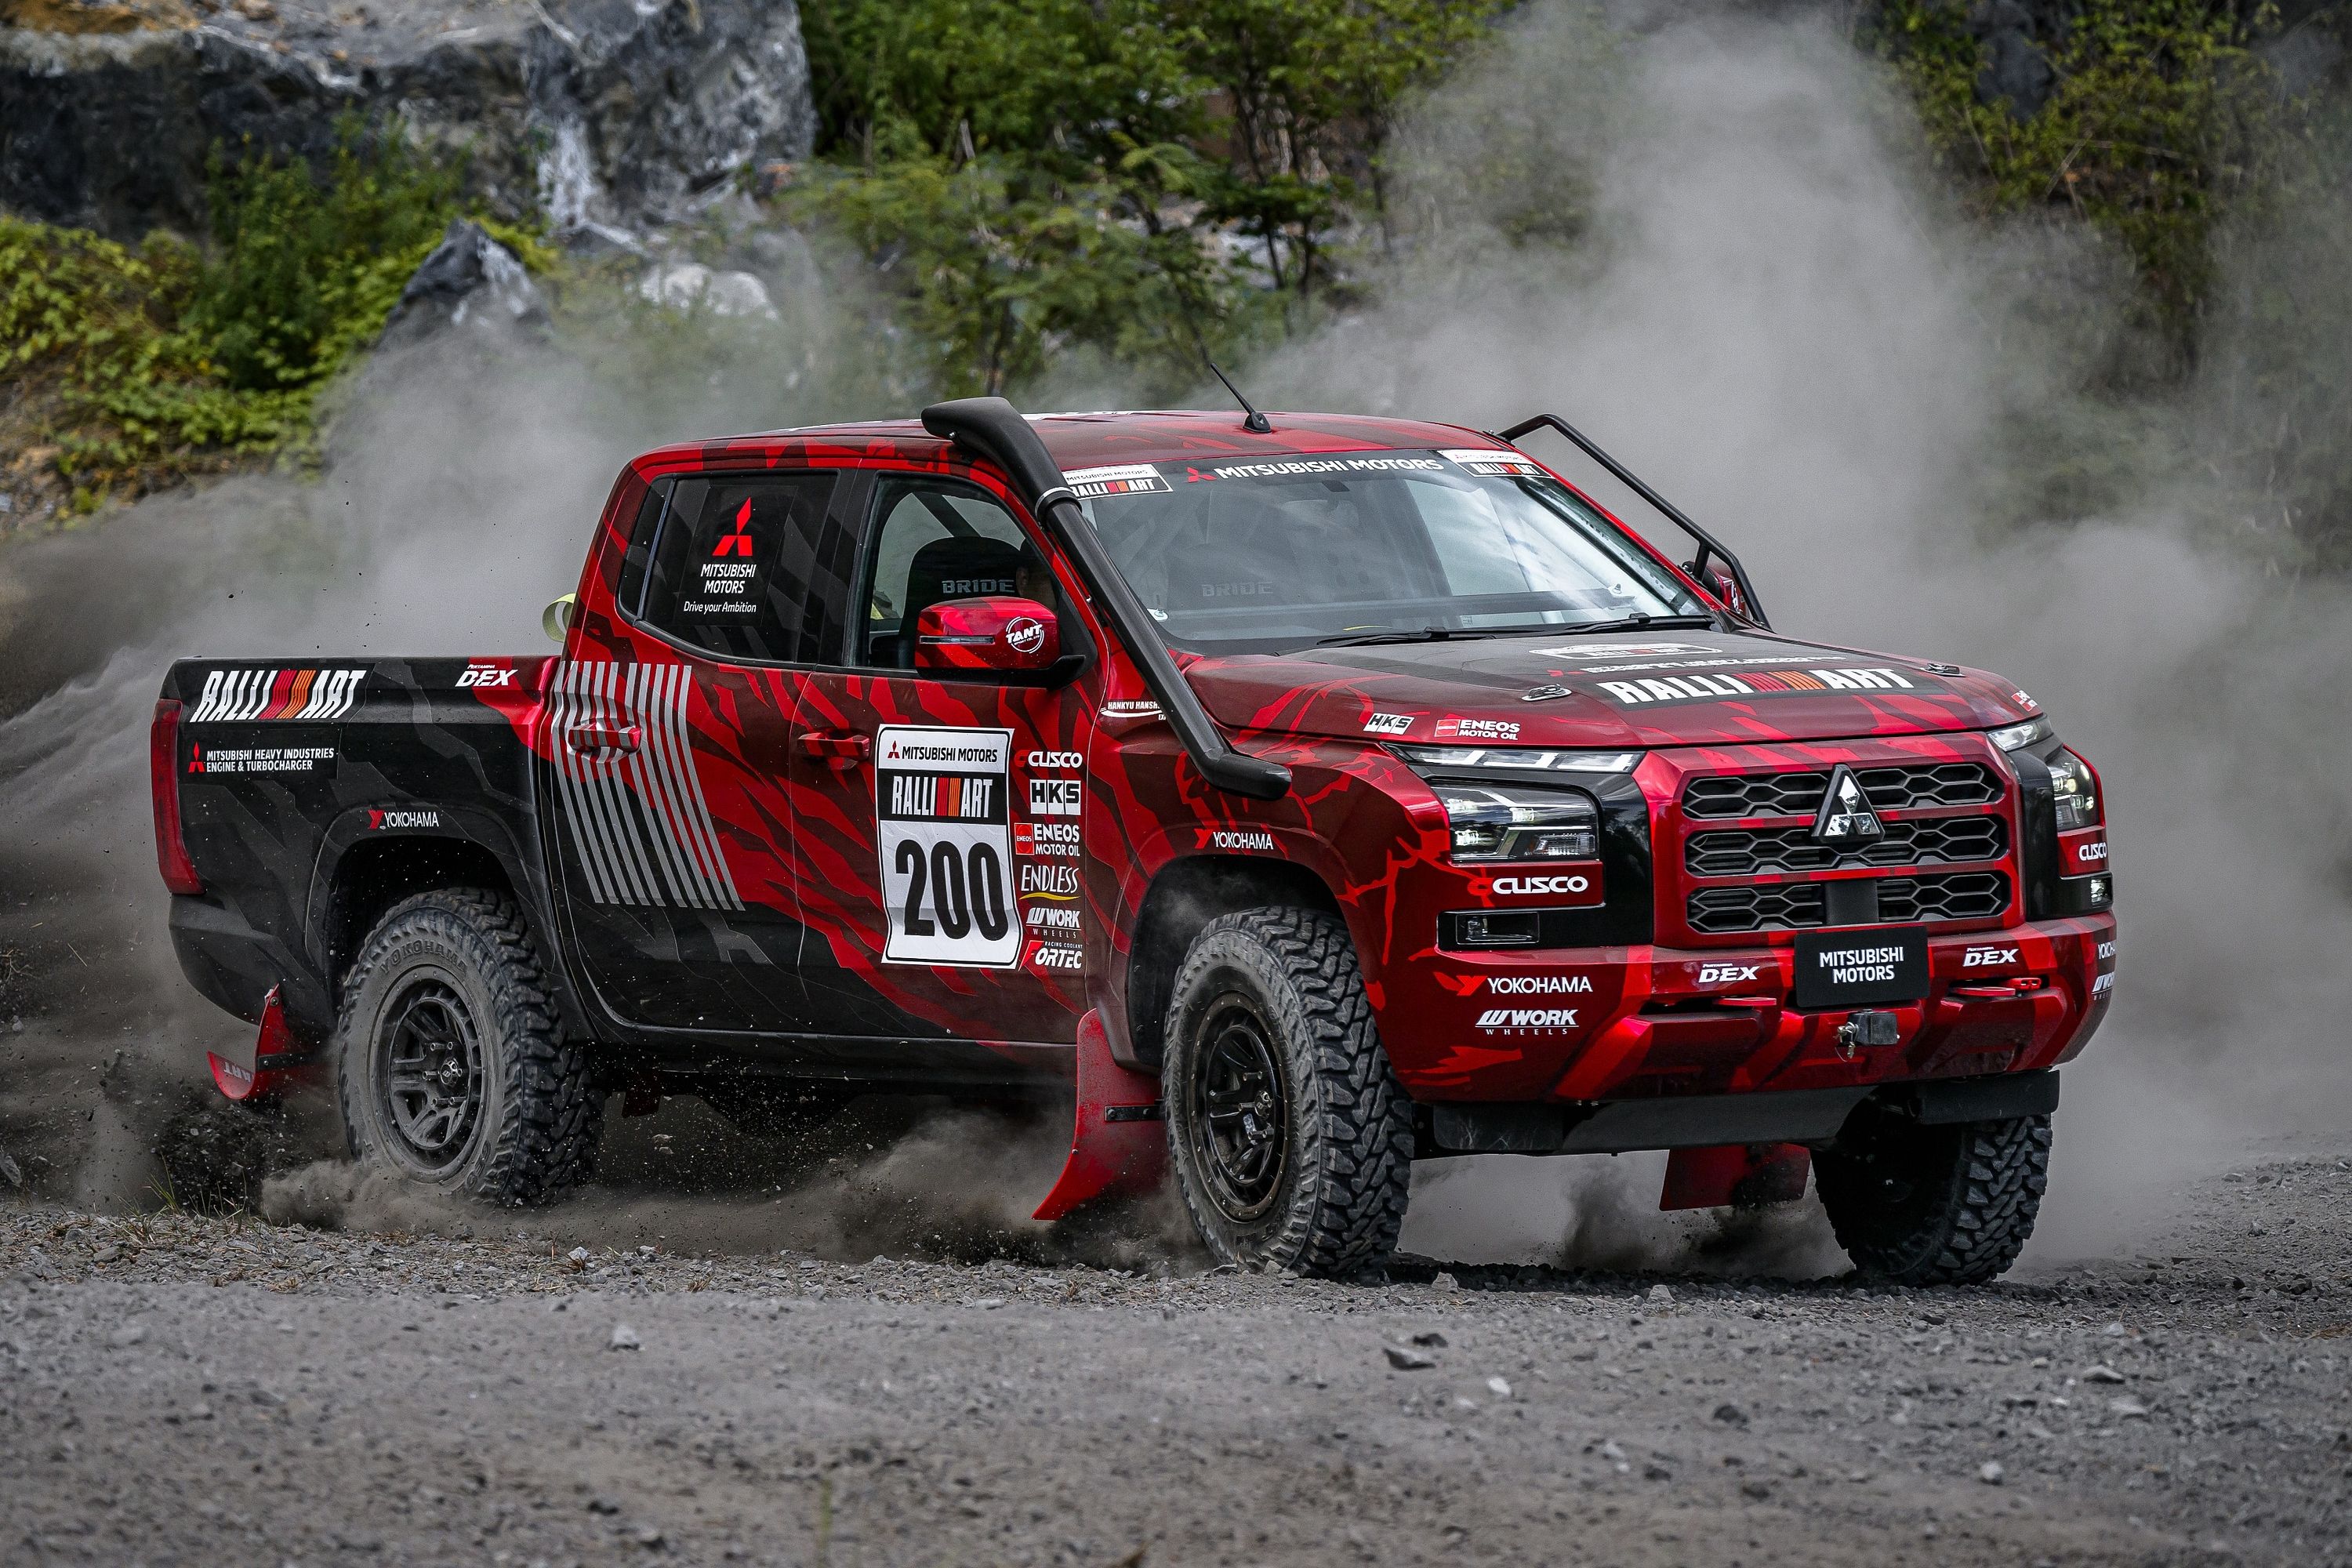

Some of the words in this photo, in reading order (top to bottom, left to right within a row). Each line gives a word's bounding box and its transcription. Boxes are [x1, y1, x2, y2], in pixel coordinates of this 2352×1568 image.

[1214, 459, 1348, 479] MITSUBISHI
[1346, 459, 1444, 470] MOTORS
[700, 564, 757, 578] MITSUBISHI
[704, 580, 745, 593] MOTORS
[942, 579, 1014, 593] BRIDE
[684, 601, 703, 612] Drive
[703, 603, 721, 615] your
[722, 601, 757, 613] Ambition
[1006, 624, 1043, 644] TANT
[455, 669, 518, 687] DEX
[1108, 701, 1134, 710] HANKYU
[1135, 701, 1160, 710] HANSH
[1458, 729, 1497, 739] MOTOR
[1501, 731, 1519, 740] OIL
[1460, 719, 1521, 733] ENEOS
[207, 750, 252, 761] MITSUBISHI
[254, 749, 282, 760] HEAVY
[283, 748, 335, 760] INDUSTRIES
[902, 746, 956, 761] MITSUBISHI
[957, 748, 998, 763] MOTORS
[1028, 751, 1083, 768] CUSCO
[206, 761, 235, 772] ENGINE
[238, 761, 245, 772] &
[246, 760, 313, 771] TURBOCHARGER
[1031, 782, 1080, 804] HKS
[384, 811, 439, 827] YOKOHAMA
[1033, 824, 1080, 843] ENEOS
[1213, 832, 1273, 850] YOKOHAMA
[1035, 844, 1066, 855] MOTOR
[1068, 845, 1080, 856] OIL
[2078, 842, 2107, 861] CUSCO
[1021, 865, 1080, 893] ENDLESS
[1492, 876, 1588, 895] CUSCO
[895, 839, 1009, 941] 200
[1033, 928, 1076, 938] WHEELS
[1819, 946, 1904, 967] MITSUBISHI
[1962, 949, 2020, 967] DEX
[1698, 966, 1760, 983] DEX
[1832, 965, 1895, 984] MOTORS
[1487, 976, 1593, 994] YOKOHAMA
